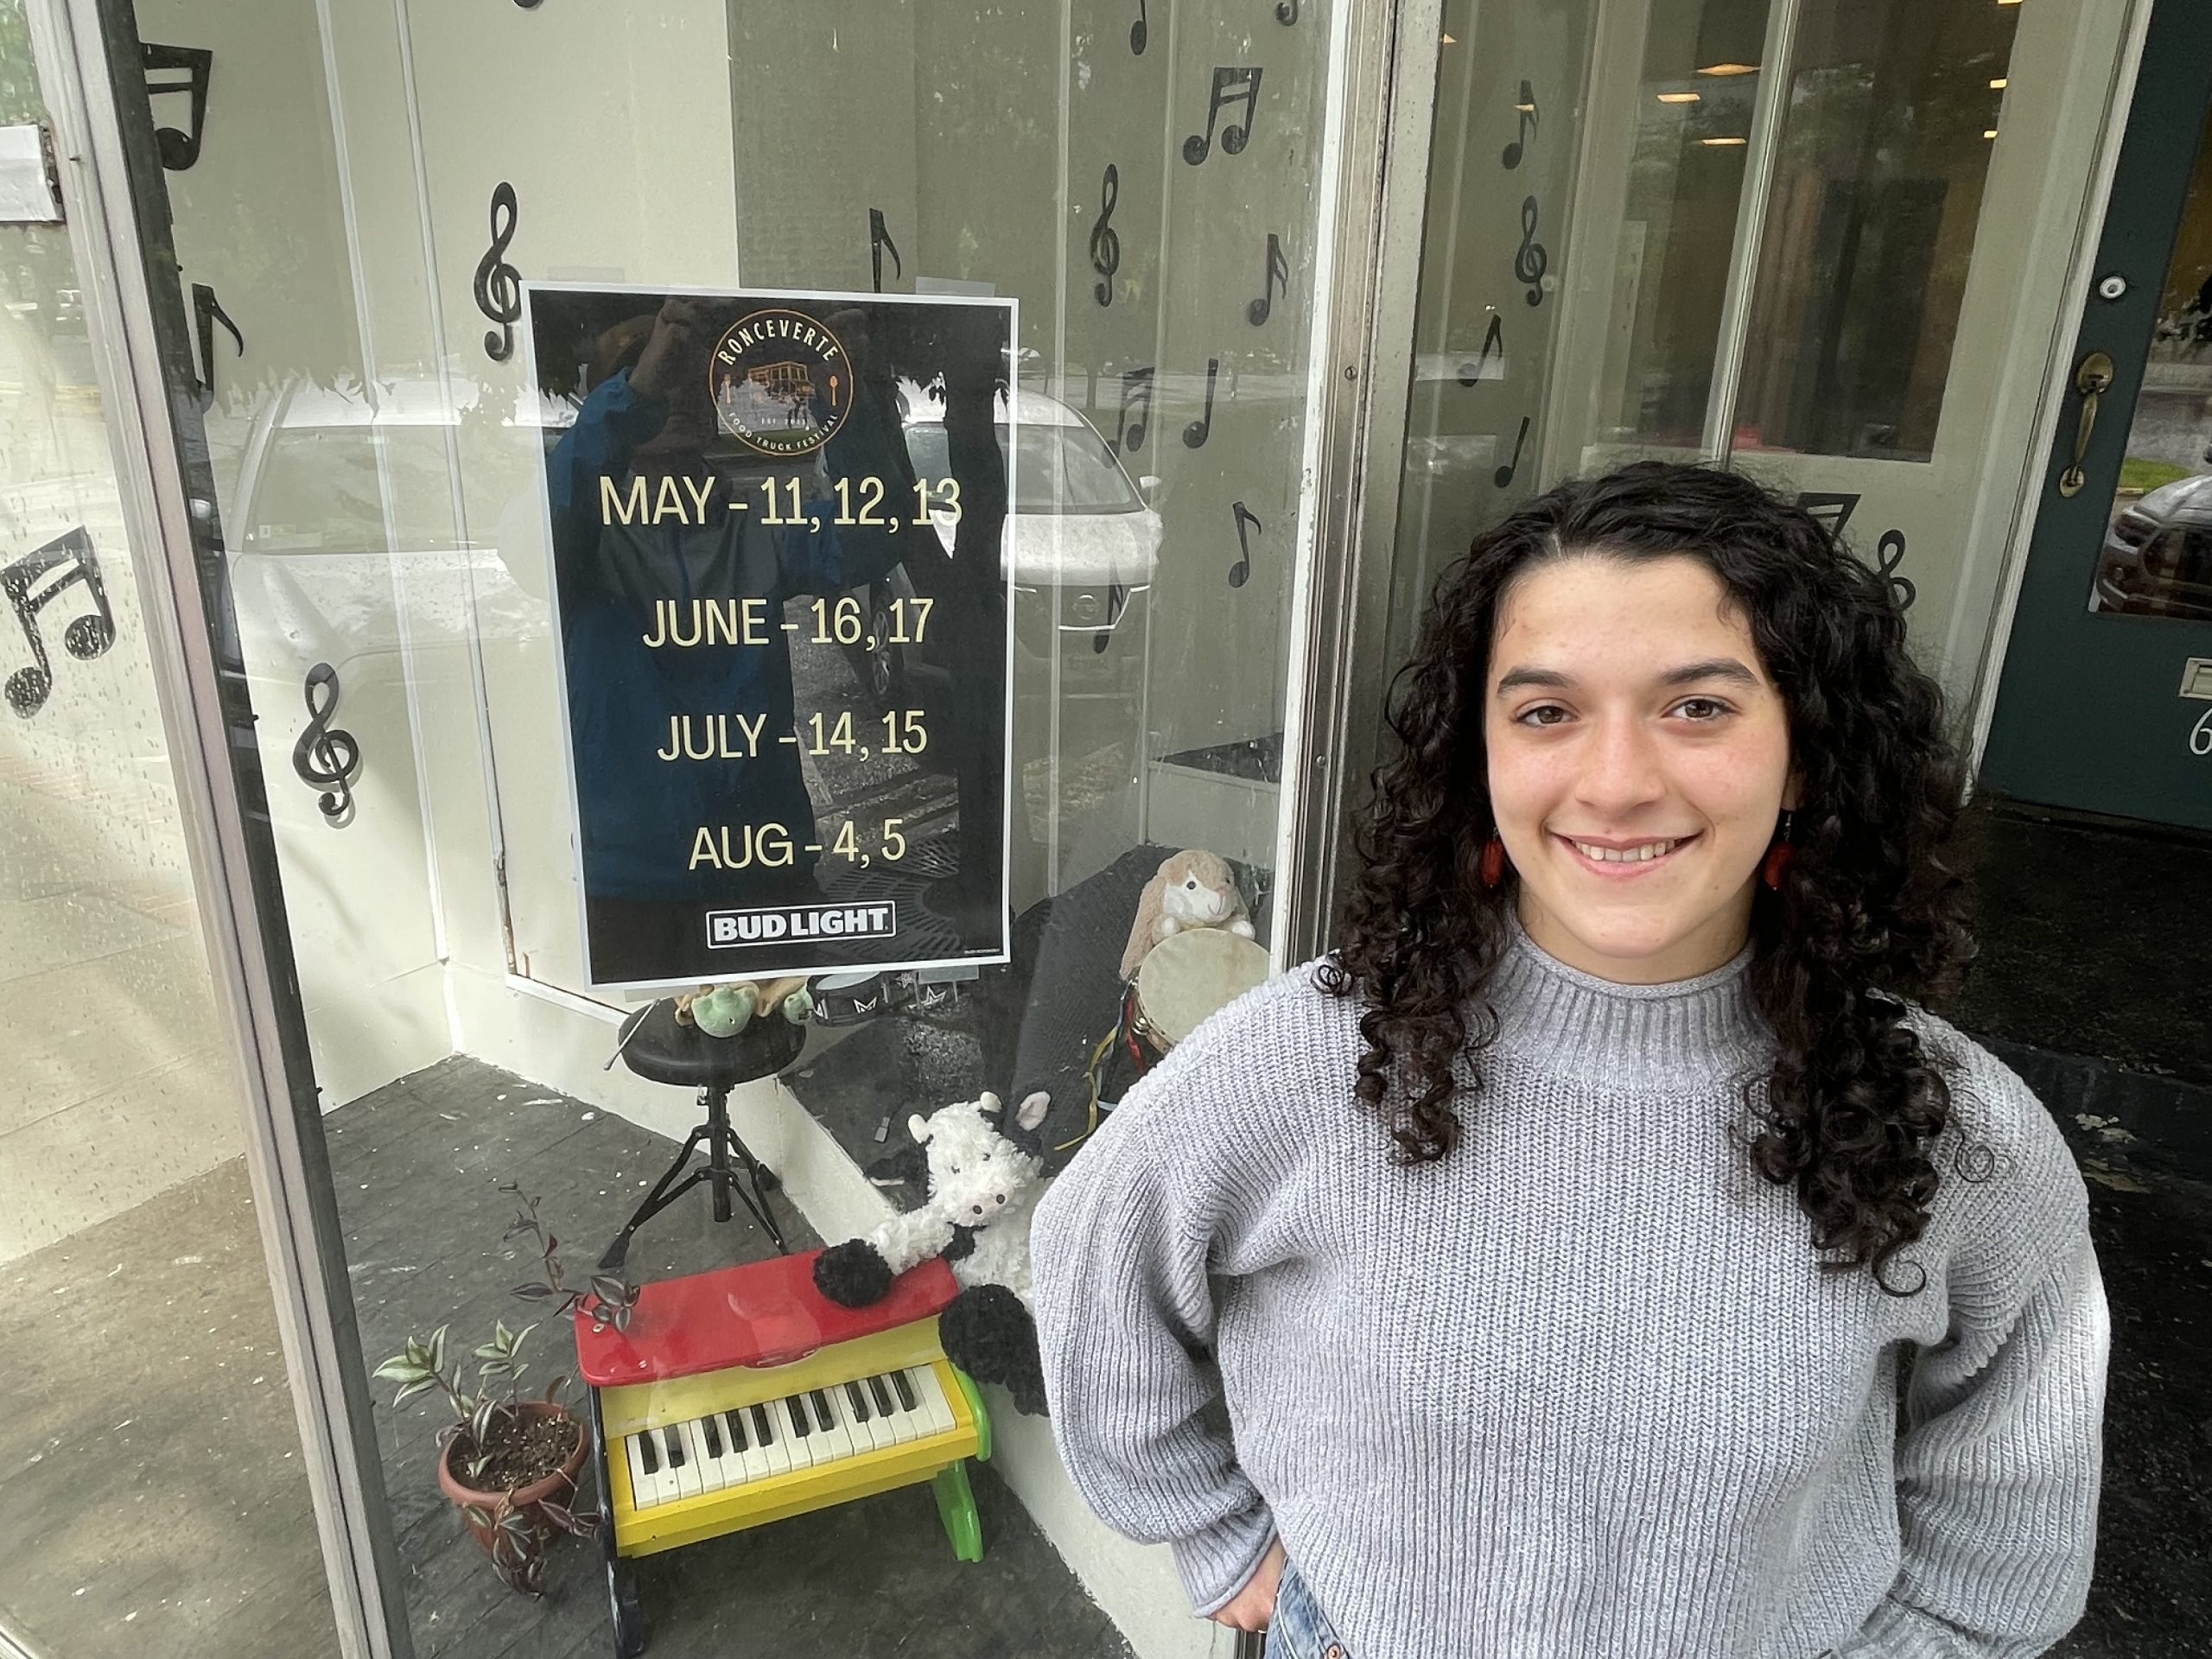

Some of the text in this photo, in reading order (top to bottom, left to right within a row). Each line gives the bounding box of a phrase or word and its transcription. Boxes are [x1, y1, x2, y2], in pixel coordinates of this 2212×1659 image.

[718, 320, 838, 365] RONCEVERTE
[757, 436, 792, 451] TRUCK
[796, 414, 838, 449] FESTIVAL
[599, 476, 715, 525] MAY
[912, 477, 963, 525] 13
[642, 599, 769, 648] JUNE
[888, 598, 934, 644] 17
[657, 713, 767, 761] JULY
[881, 709, 928, 753] 15
[689, 823, 794, 871] AUG
[880, 818, 906, 861] 5
[714, 907, 889, 942] BUD LIGHT
